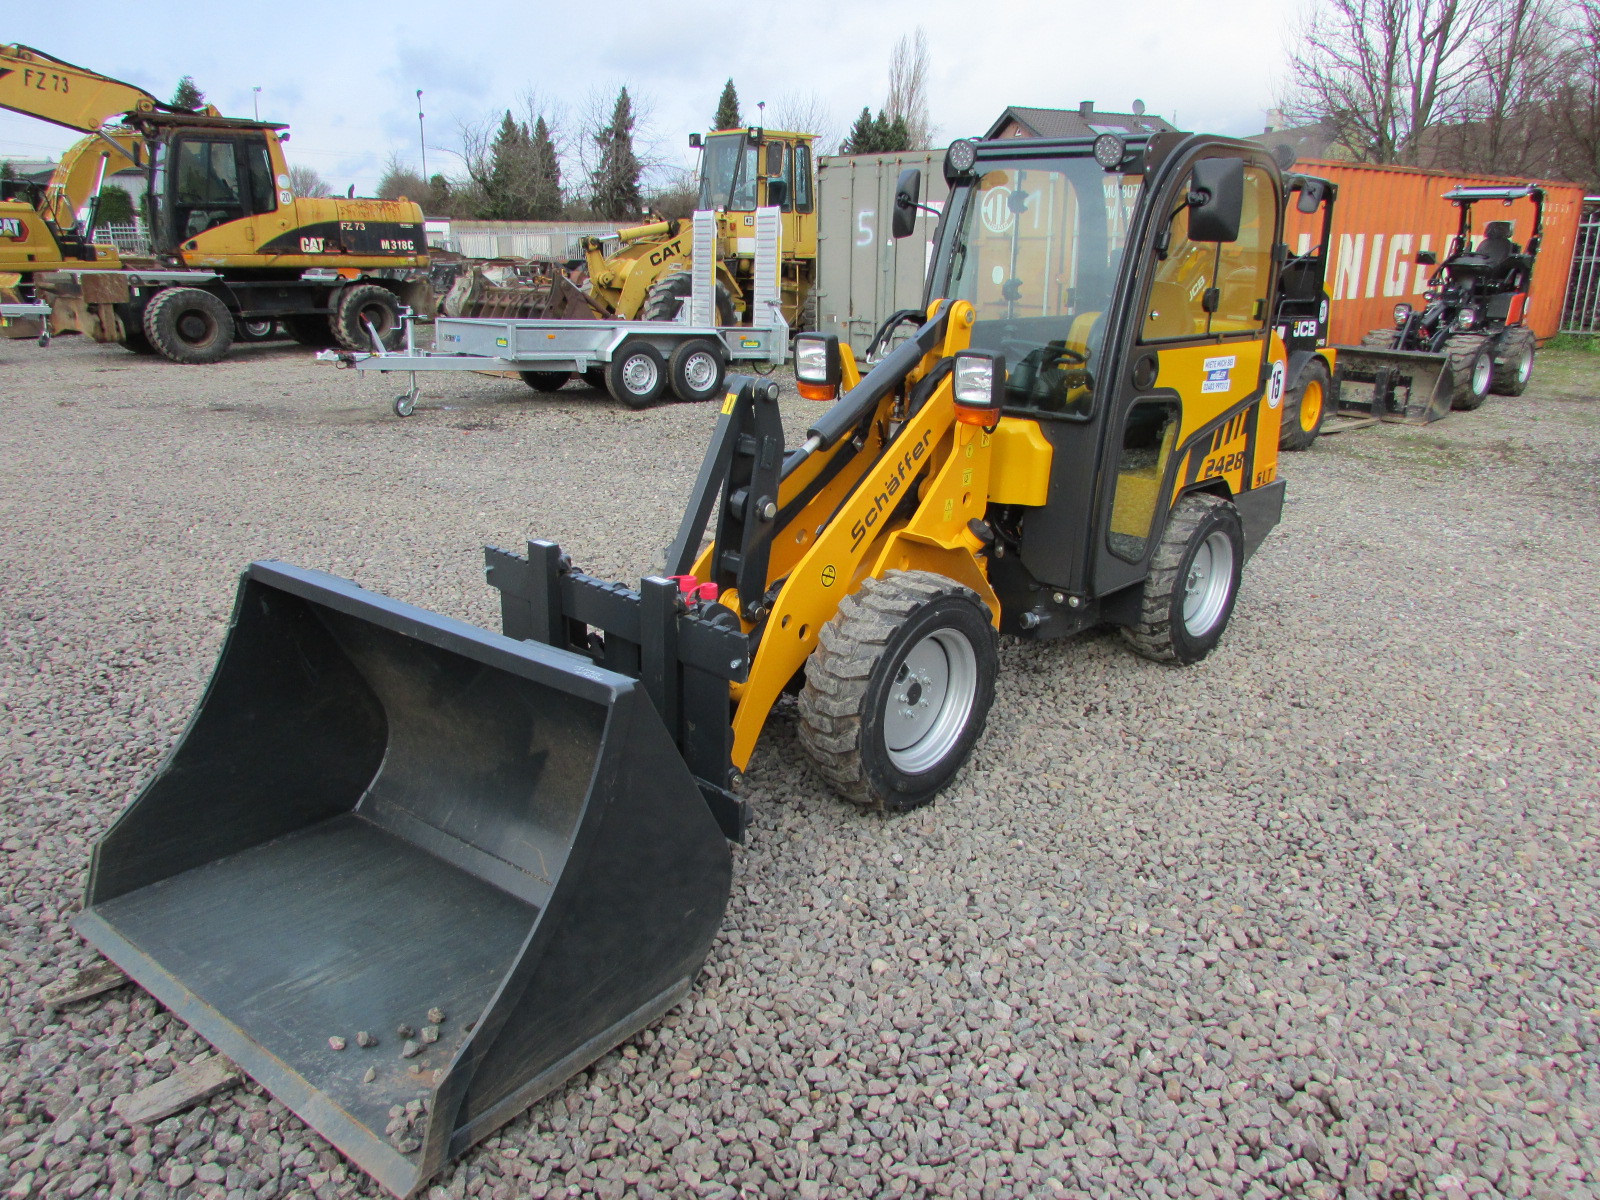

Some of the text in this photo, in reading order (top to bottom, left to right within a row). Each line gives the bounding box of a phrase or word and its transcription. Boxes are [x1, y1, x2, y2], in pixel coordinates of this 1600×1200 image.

[24, 68, 69, 93] FZ 73
[340, 222, 366, 231] FZ 73
[857, 210, 875, 245] 5
[301, 237, 325, 253] CAT
[649, 240, 682, 267] CAT
[1189, 275, 1206, 302] JCB
[1293, 320, 1317, 337] JCB
[1271, 370, 1282, 400] 15
[1204, 450, 1245, 480] 2428
[1255, 467, 1273, 487] SLT
[850, 429, 932, 554] Schäffer
